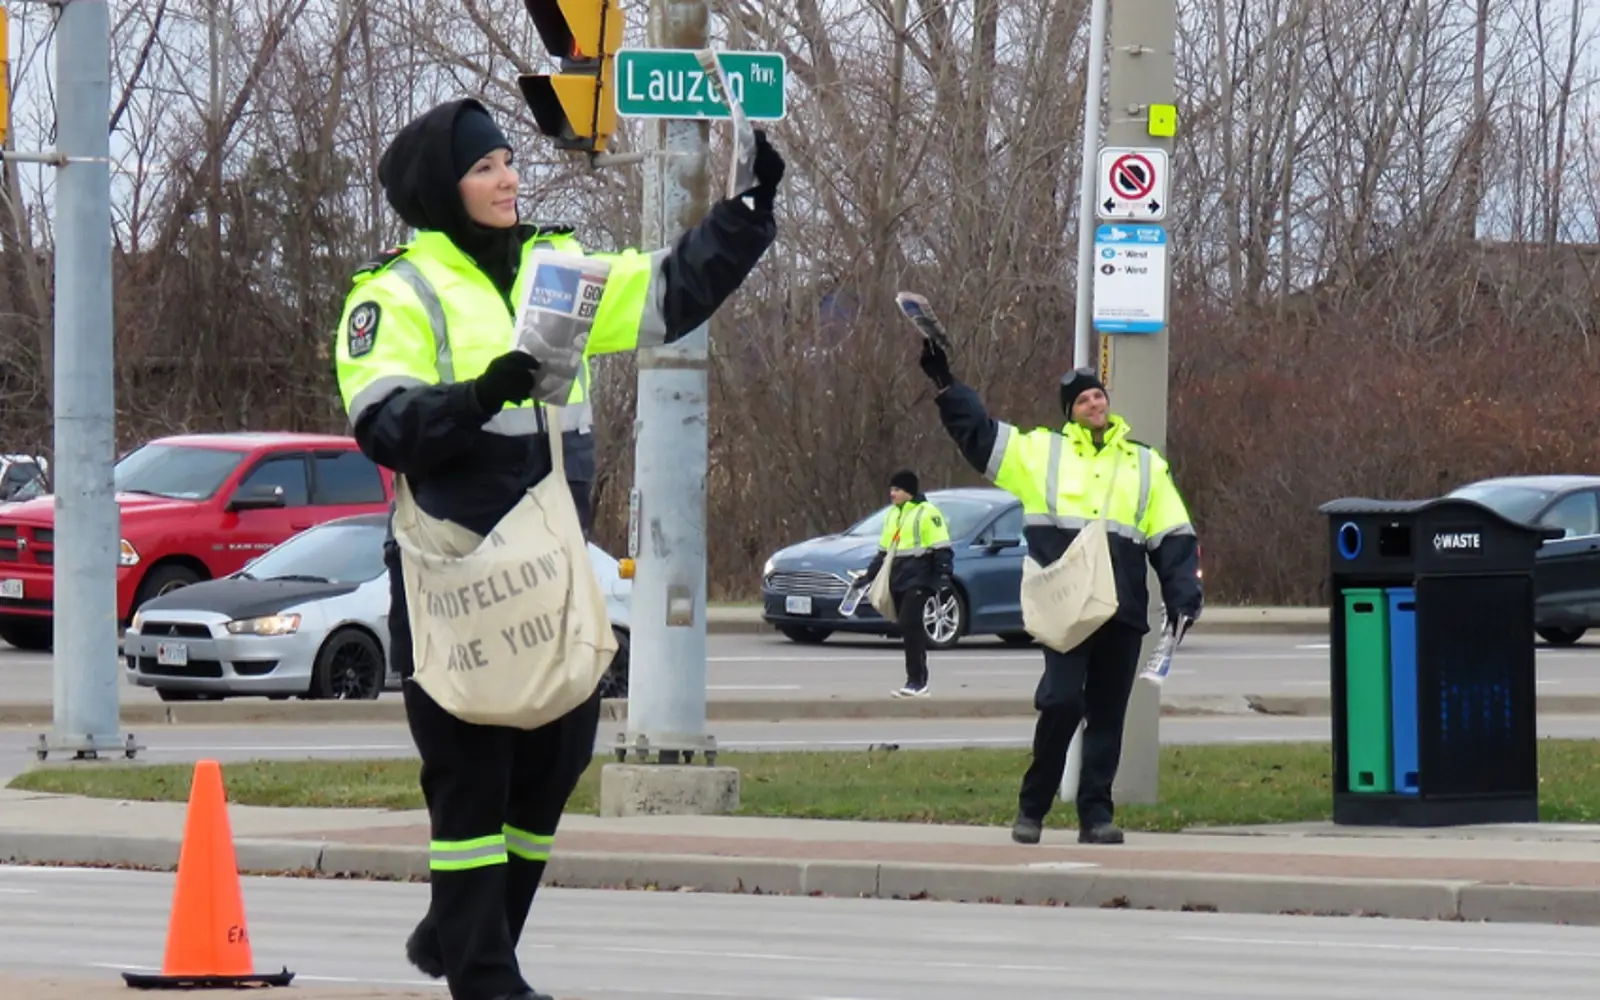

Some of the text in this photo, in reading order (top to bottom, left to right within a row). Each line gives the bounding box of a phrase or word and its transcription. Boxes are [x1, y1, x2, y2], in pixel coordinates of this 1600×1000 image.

[751, 62, 777, 86] Pkwy.
[1125, 250, 1149, 259] West
[1125, 265, 1149, 275] West
[1441, 533, 1481, 548] WASTE
[446, 638, 489, 673] ARE
